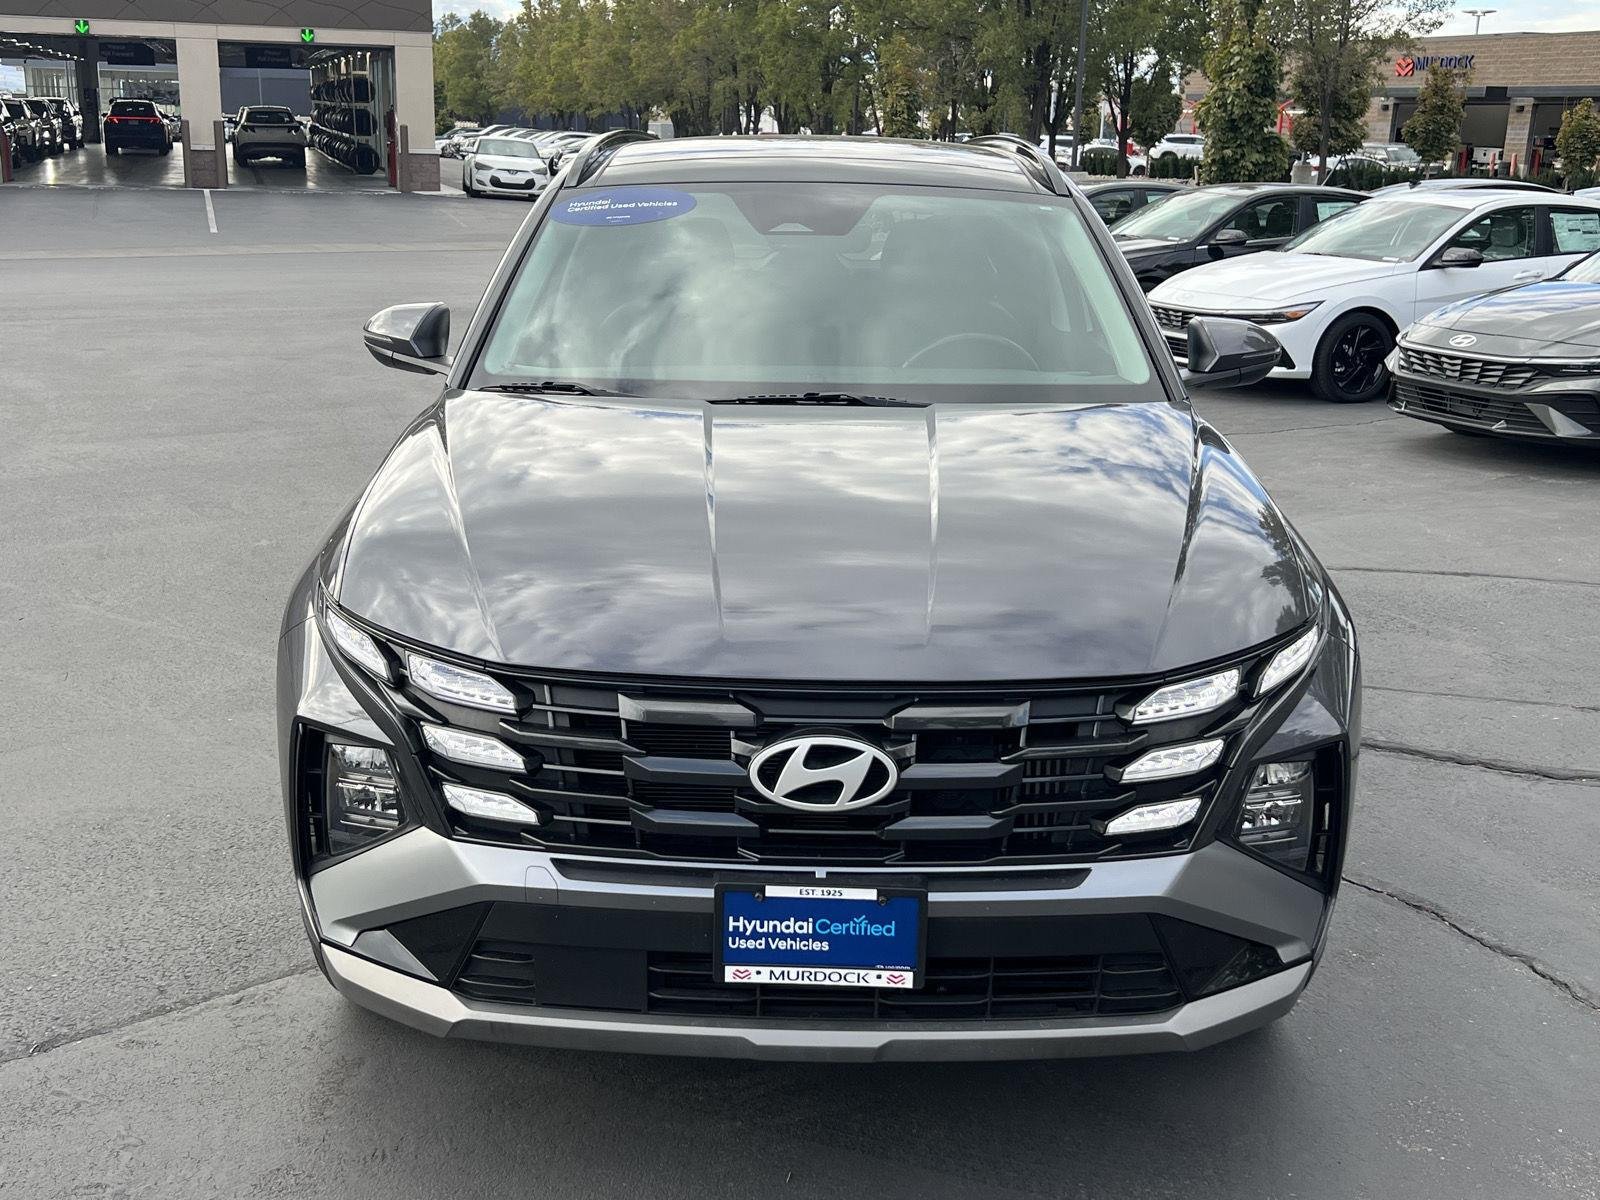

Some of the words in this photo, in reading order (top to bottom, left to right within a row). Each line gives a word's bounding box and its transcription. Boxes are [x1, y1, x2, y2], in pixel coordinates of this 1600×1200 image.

[1415, 55, 1475, 70] MUDOCK
[567, 204, 609, 213] Certified
[637, 200, 678, 208] Vehicles
[569, 199, 611, 207] Hyundai
[799, 887, 819, 896] EST.
[820, 888, 843, 897] 1925
[728, 916, 813, 936] Hyundai
[815, 915, 896, 937] Certified
[728, 937, 765, 949] Used
[768, 937, 830, 951] Vehicles
[769, 969, 869, 984] MURDOCK
